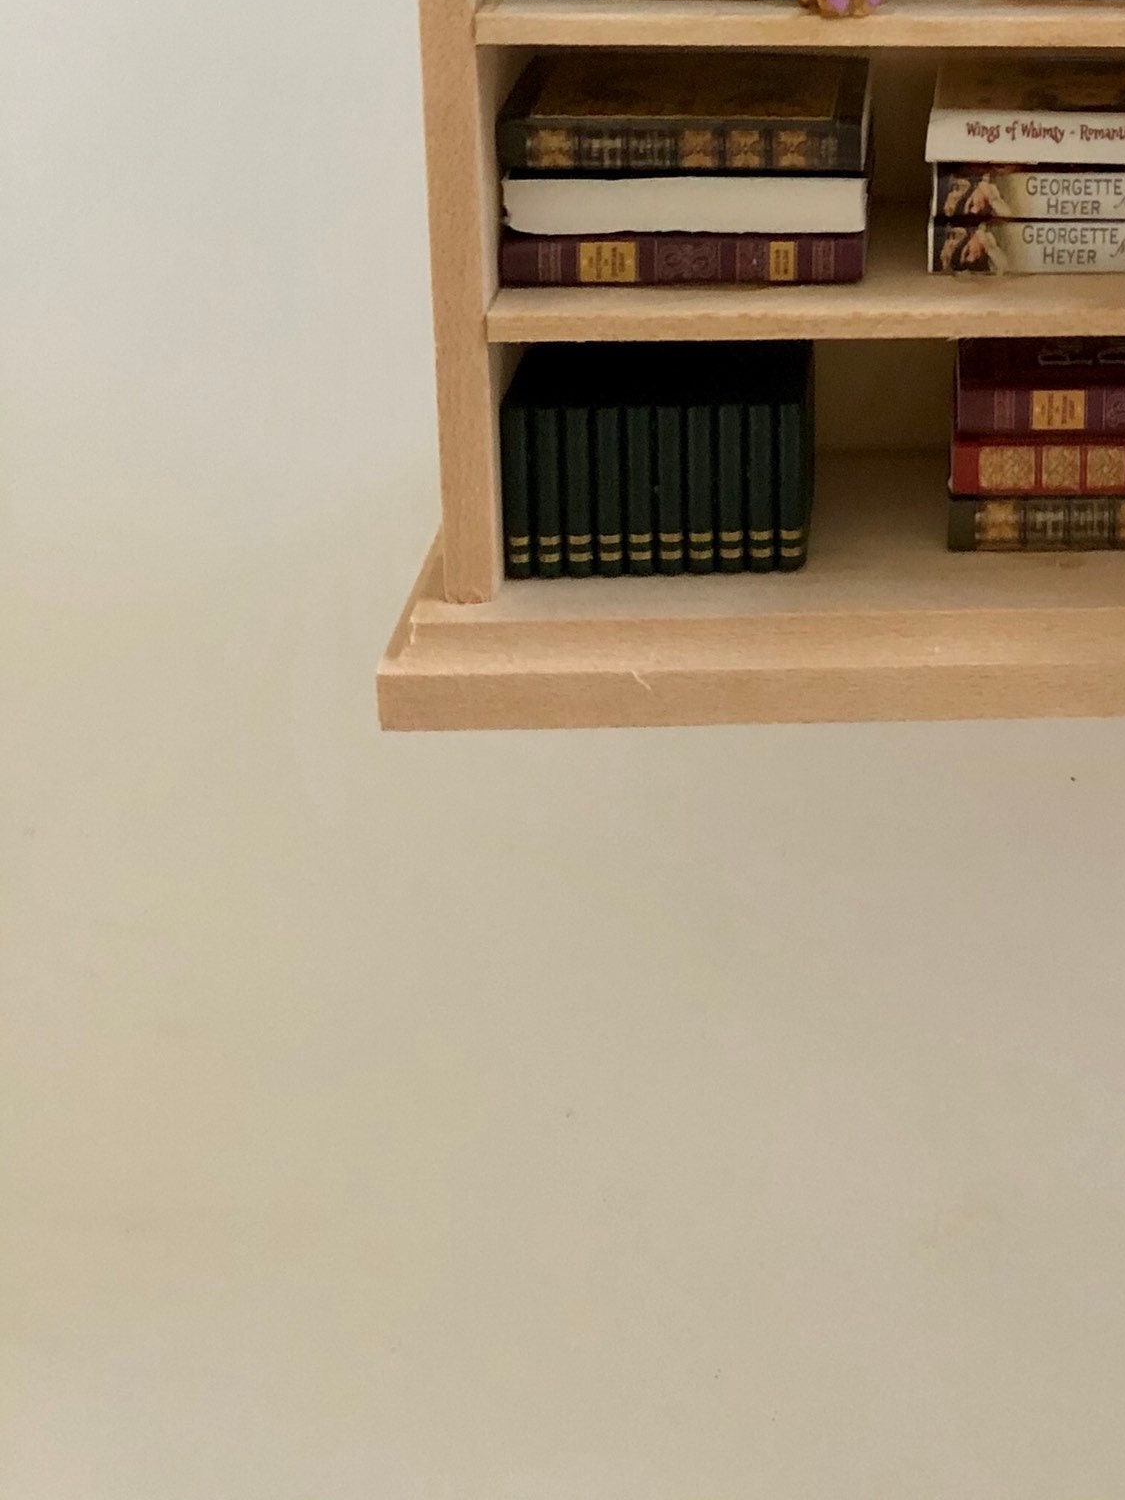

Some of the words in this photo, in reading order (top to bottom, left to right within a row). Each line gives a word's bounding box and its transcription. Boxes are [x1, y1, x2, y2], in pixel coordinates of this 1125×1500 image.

[966, 121, 1000, 143] Wings
[1005, 120, 1018, 141] of
[1020, 121, 1065, 144] Whimsy
[1025, 176, 1123, 197] GEORGETTE
[1046, 199, 1101, 216] HEYER
[1022, 225, 1119, 246] GEORGETTE
[1042, 249, 1097, 266] HEYER
